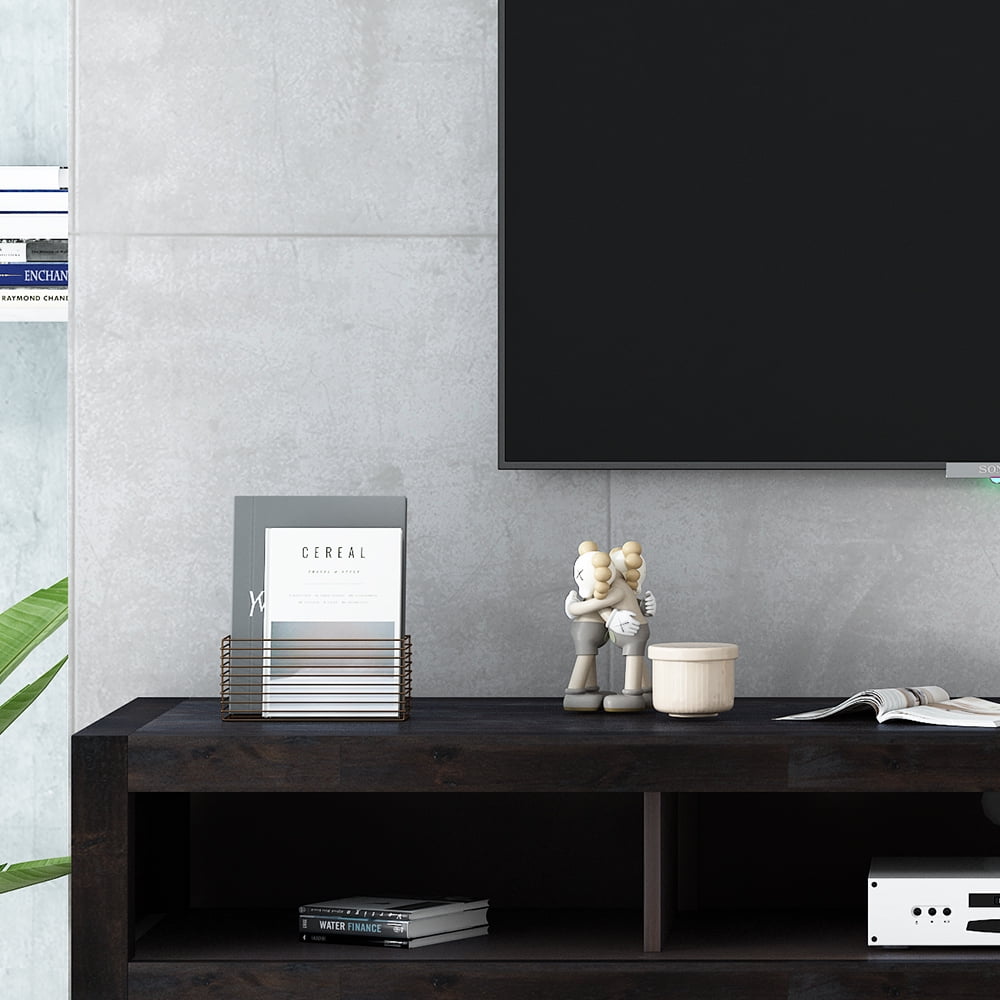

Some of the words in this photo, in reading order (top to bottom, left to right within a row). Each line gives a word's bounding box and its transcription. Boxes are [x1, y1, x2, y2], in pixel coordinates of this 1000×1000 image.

[302, 546, 366, 559] CEREAL
[319, 920, 346, 931] WATER
[347, 922, 382, 933] FINANCE
